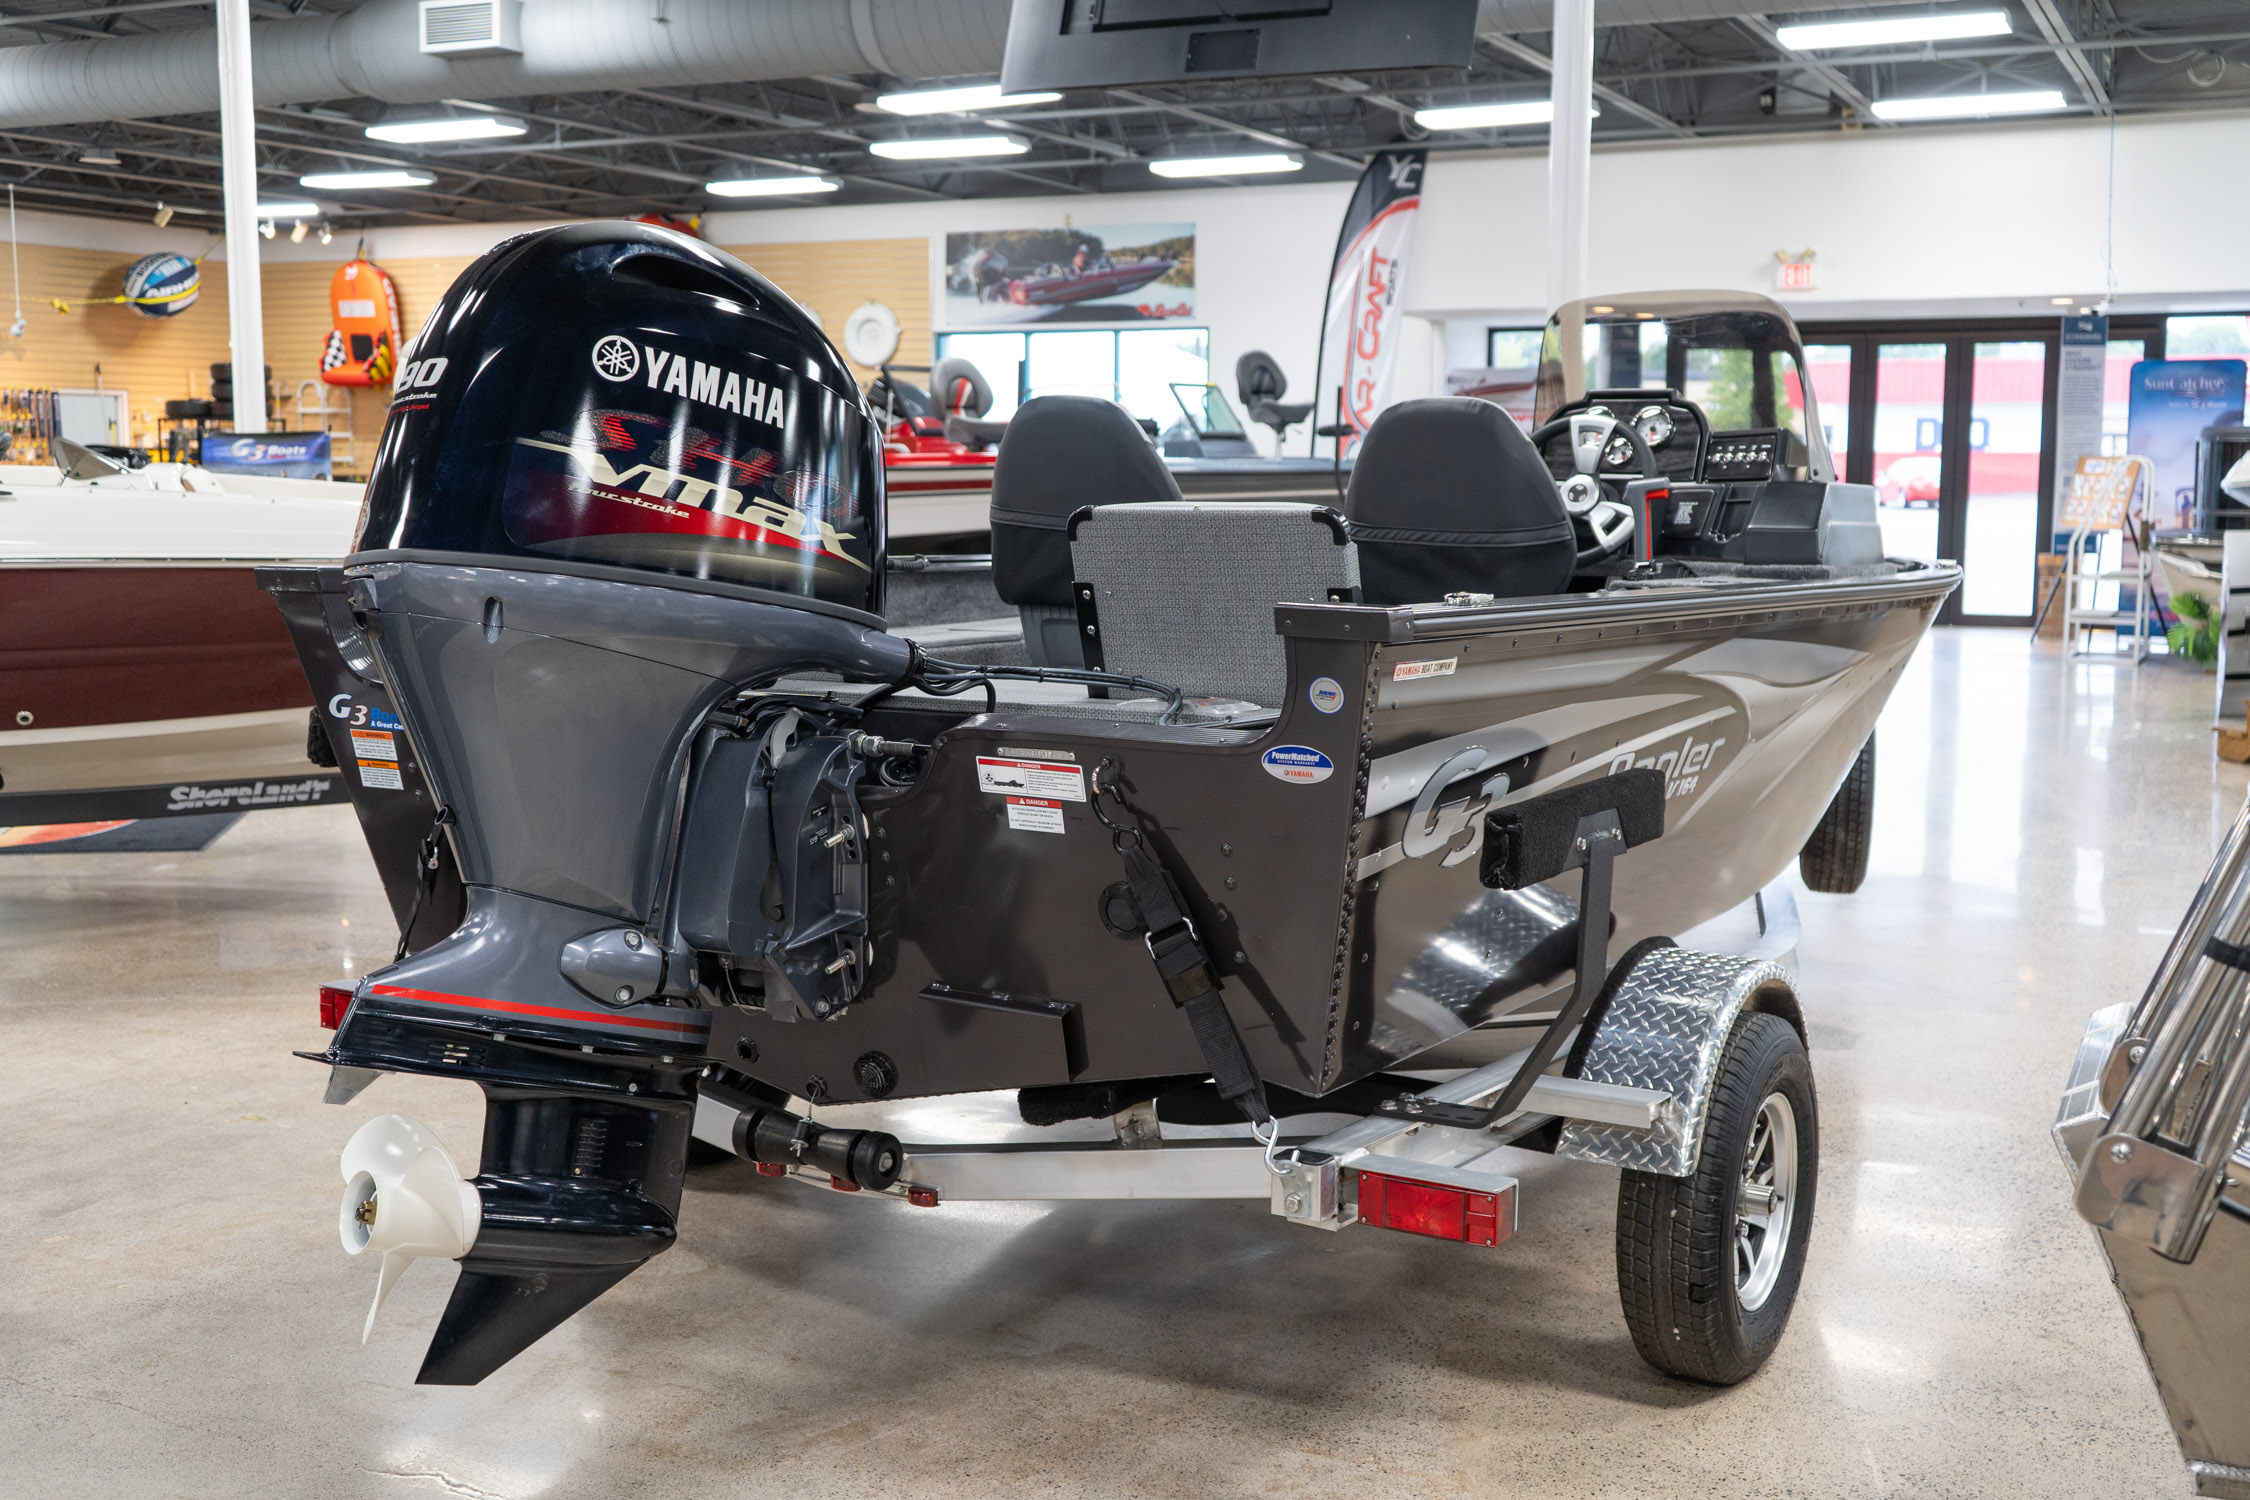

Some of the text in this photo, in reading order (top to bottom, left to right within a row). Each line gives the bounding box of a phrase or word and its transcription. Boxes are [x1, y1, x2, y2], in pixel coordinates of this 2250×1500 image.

[1784, 263, 1812, 288] EXIT
[396, 357, 449, 394] 90
[644, 345, 785, 430] YAMAHA
[230, 437, 308, 461] G3 Boats
[1402, 661, 1455, 677] YAMAHA BOAT COMPANY
[328, 693, 399, 726] G3 Boa
[376, 721, 393, 729] Great
[1271, 751, 1320, 762] PowerMatched
[1290, 770, 1314, 778] YAMAHA
[1402, 744, 1511, 868] G3
